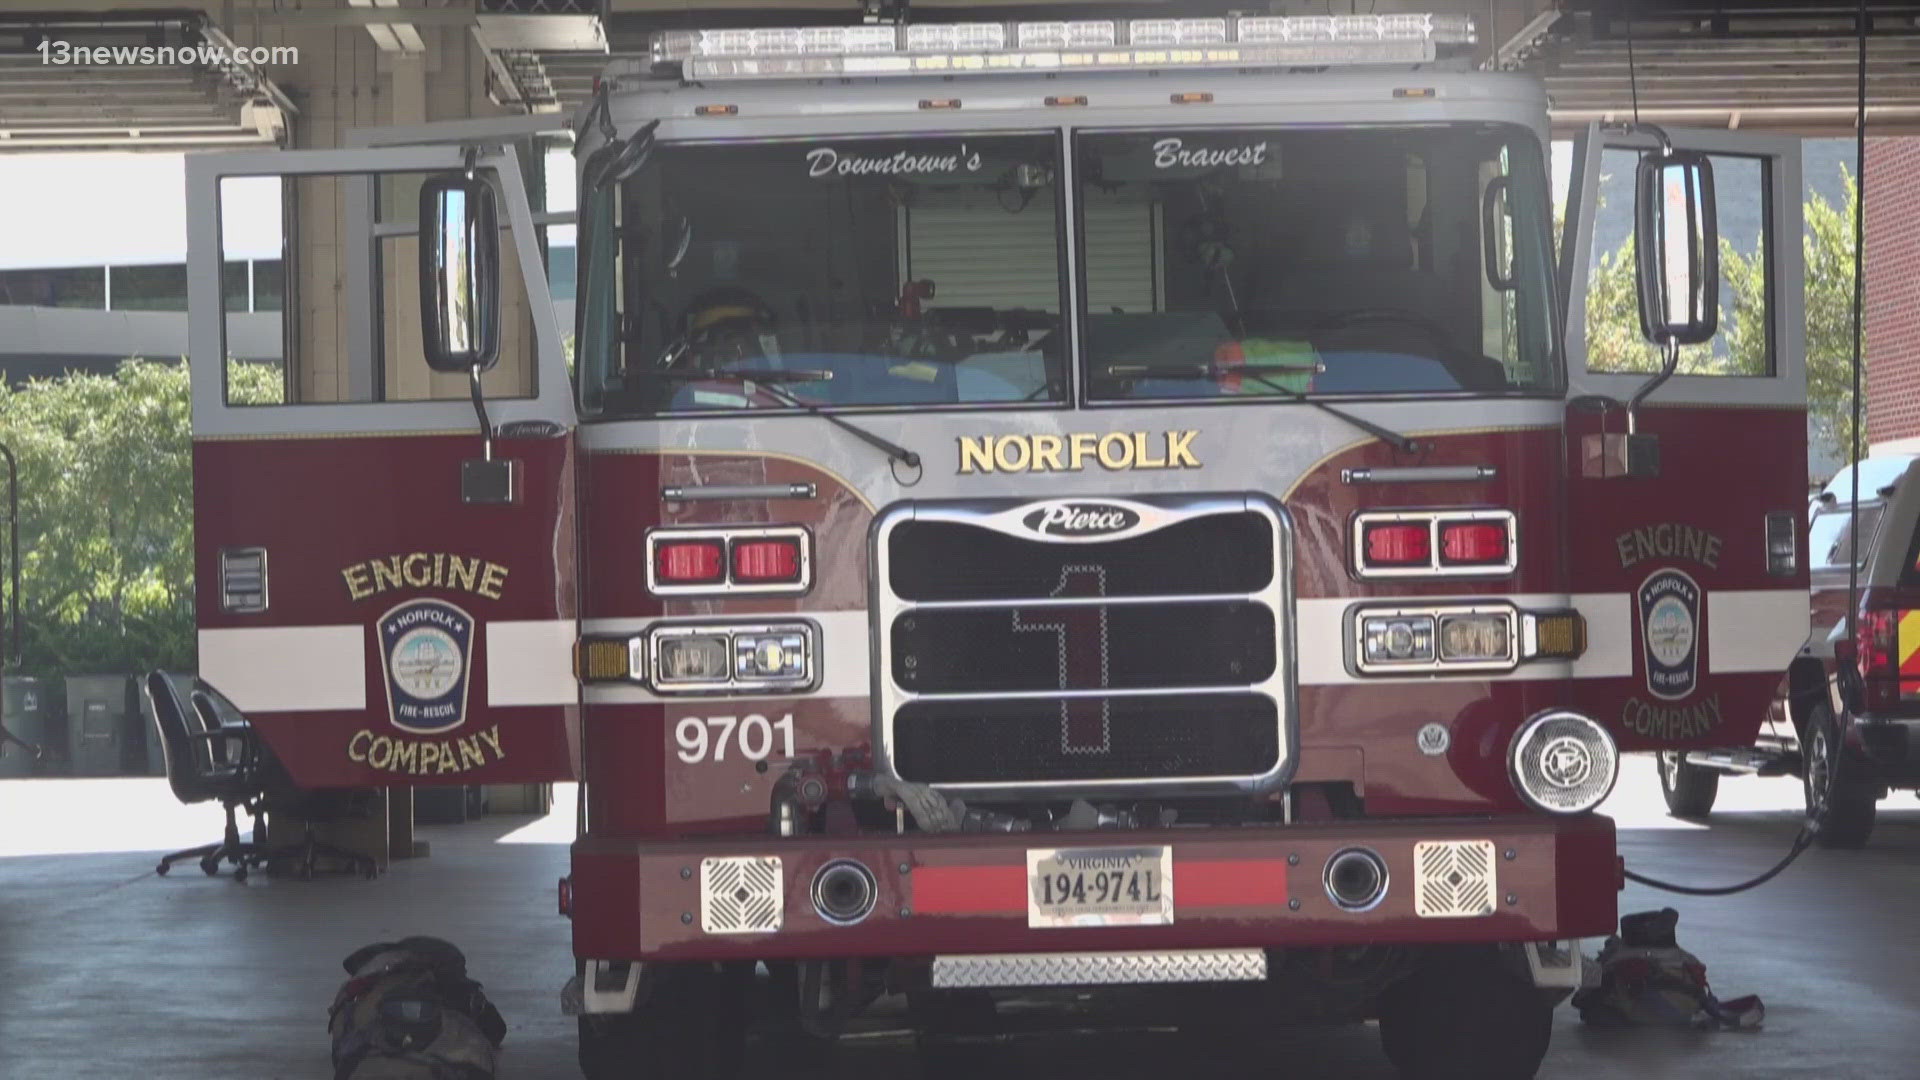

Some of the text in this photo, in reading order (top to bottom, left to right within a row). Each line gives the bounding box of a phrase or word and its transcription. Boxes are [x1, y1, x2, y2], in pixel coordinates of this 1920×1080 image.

[806, 138, 1269, 178] Downtown's Bravest
[957, 429, 1203, 476] NORFOLK
[1037, 503, 1126, 535] Pierce
[1615, 523, 1723, 570] ENGINE
[341, 552, 510, 601] ENGINE
[1650, 577, 1689, 597] NORFOLK
[396, 608, 456, 630] NORFOLK
[399, 702, 457, 719] FIRE-RESCUE
[1621, 692, 1724, 741] COMPANY
[348, 723, 506, 775] COMPANY
[675, 713, 796, 764] 9701
[1068, 856, 1132, 871] VIRGINIA
[1042, 870, 1161, 906] 194-974L
